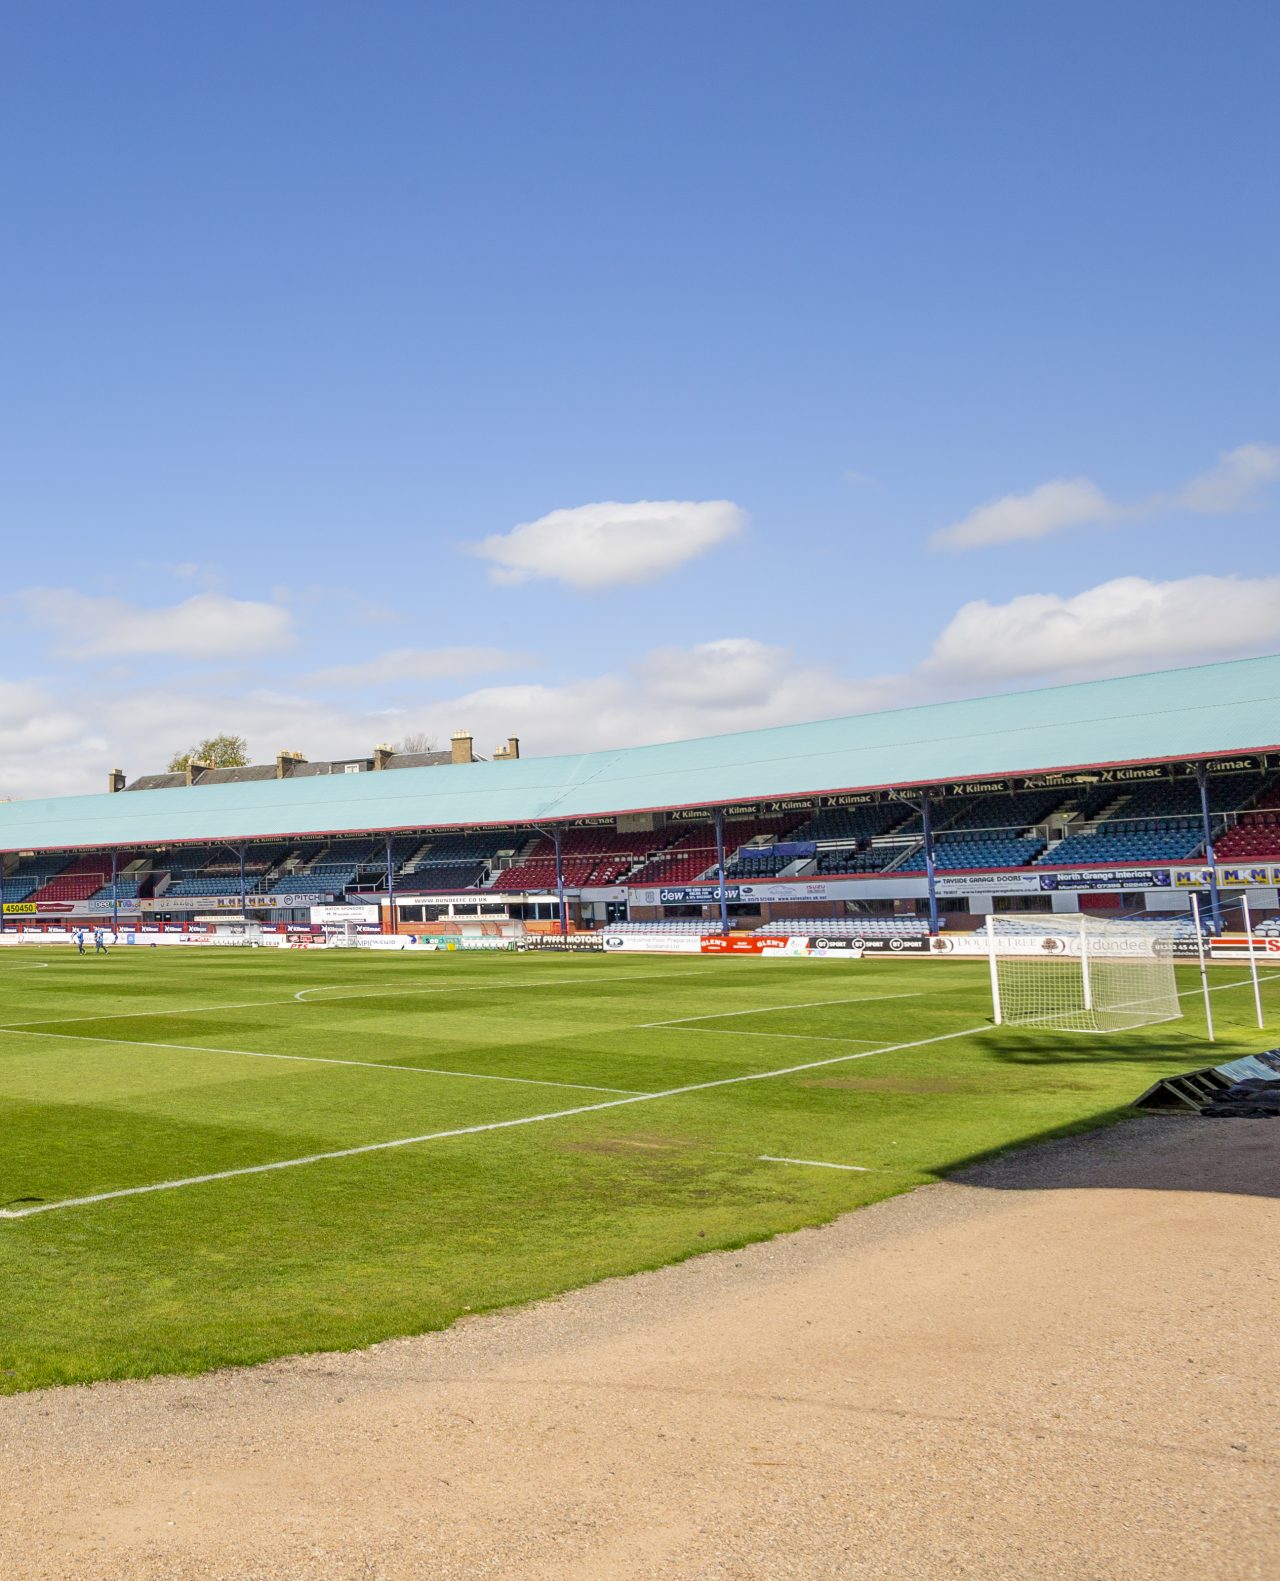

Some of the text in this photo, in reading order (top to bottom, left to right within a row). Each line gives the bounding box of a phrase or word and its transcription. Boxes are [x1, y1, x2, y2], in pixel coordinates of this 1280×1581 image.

[1117, 767, 1162, 780] Kilmac
[966, 782, 1004, 793] Kilmac
[839, 795, 871, 805] Kilmac
[729, 805, 757, 815] Kilmac
[782, 801, 812, 810] Kilmac
[1082, 872, 1113, 881] Grange
[1115, 871, 1152, 879] Interiors
[1224, 869, 1266, 882] MKM
[661, 889, 685, 900] dew
[6, 904, 33, 913] 450450
[701, 939, 727, 947] GLEN'S
[756, 939, 785, 948] GLEN'S
